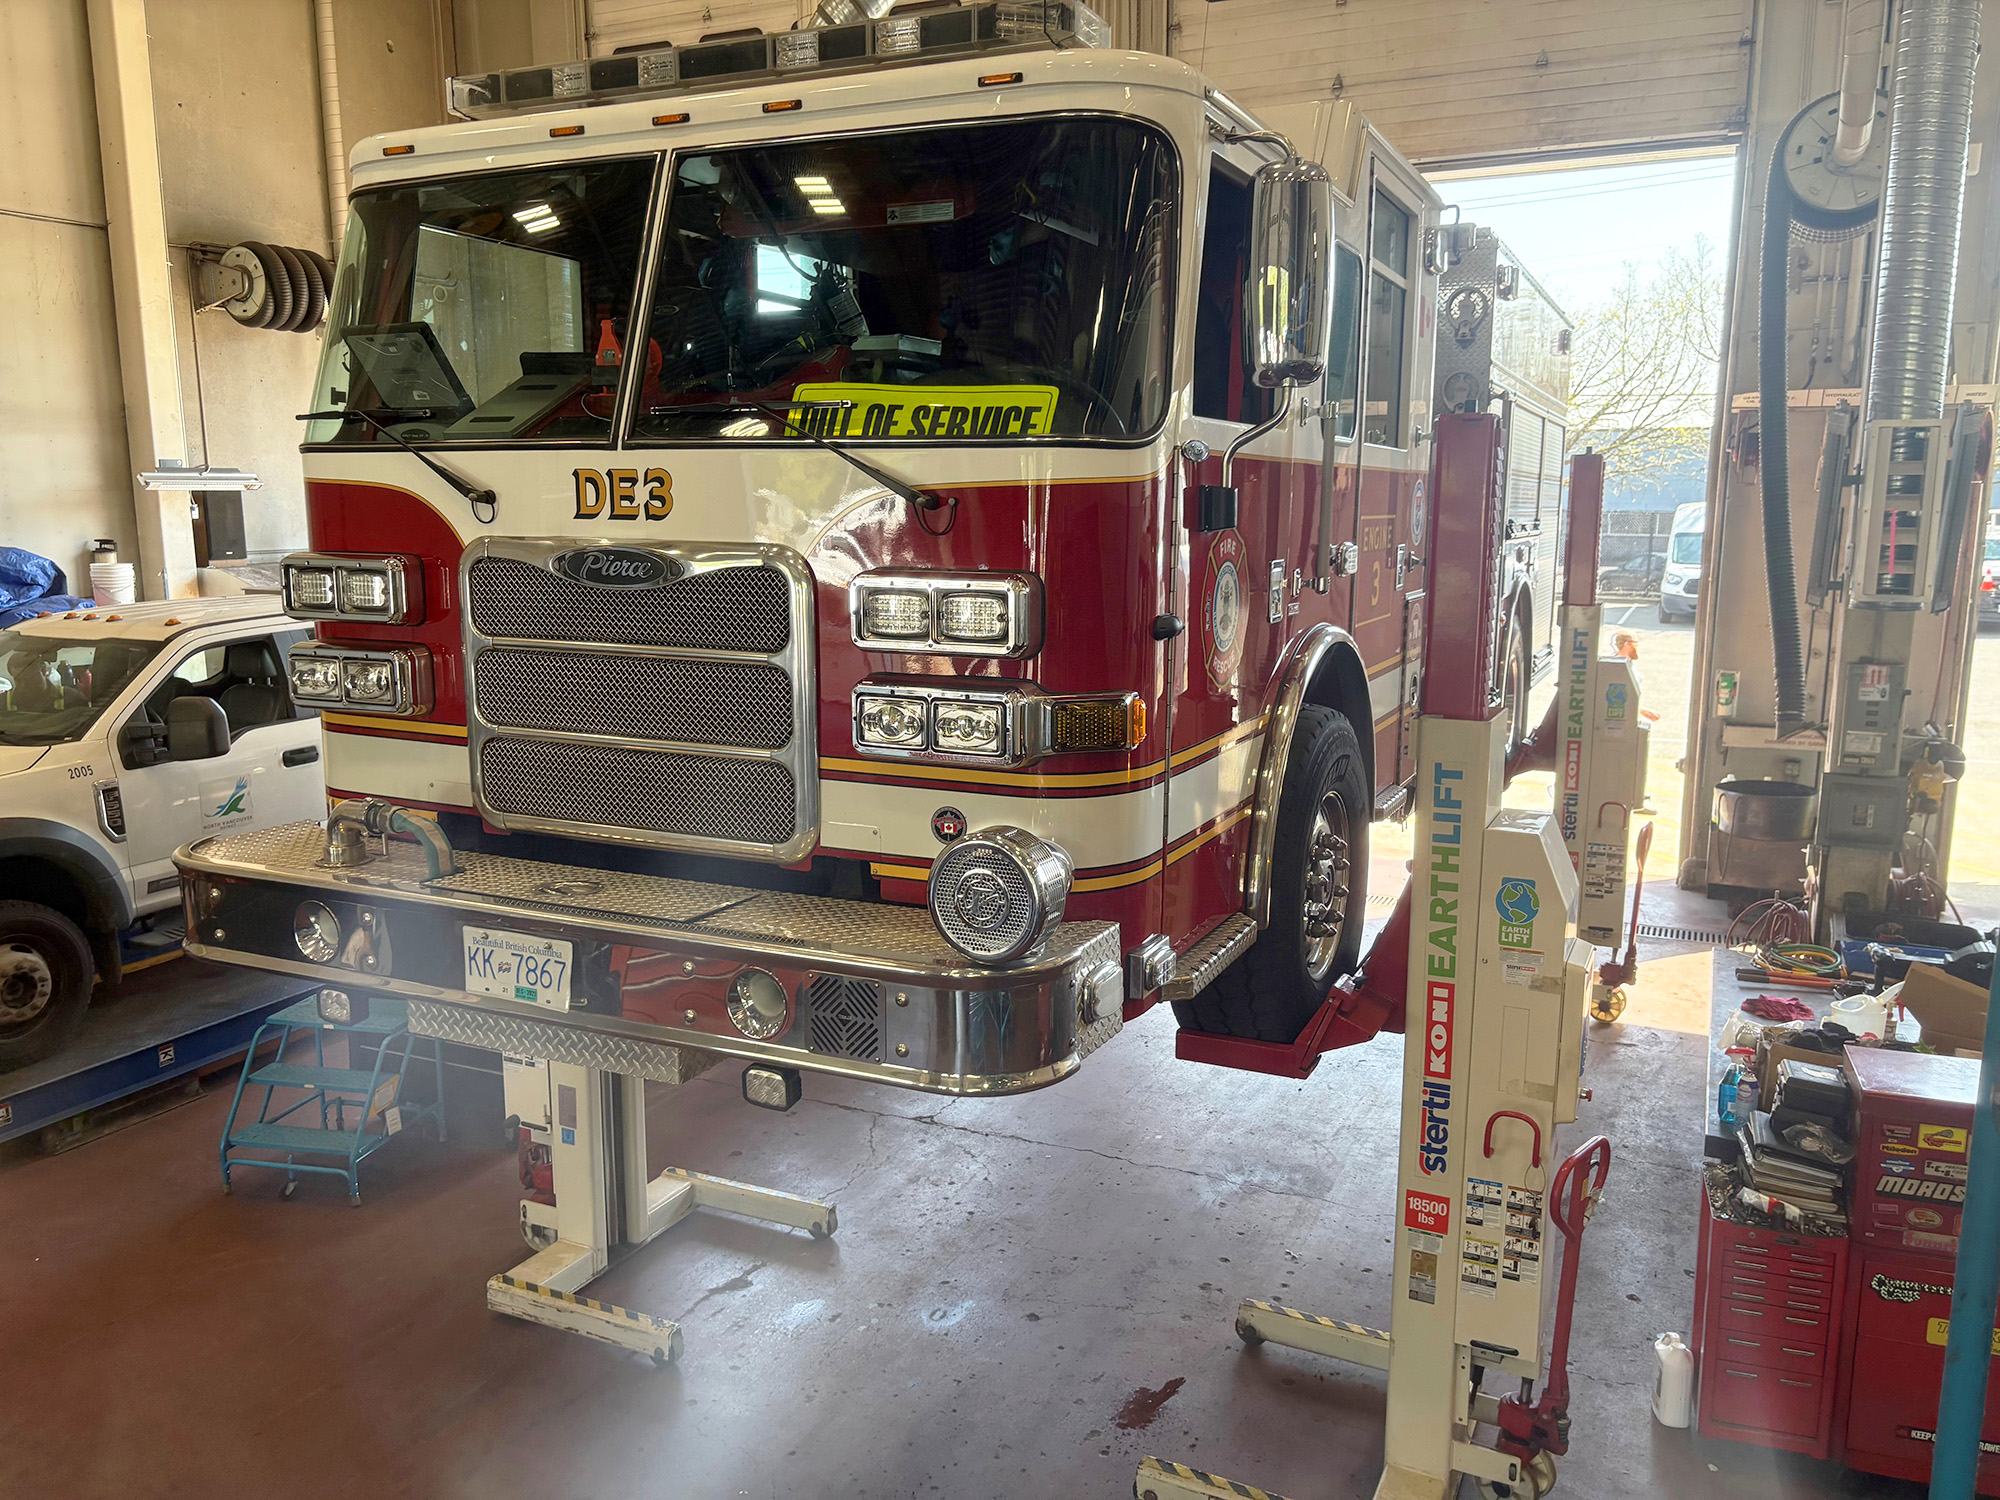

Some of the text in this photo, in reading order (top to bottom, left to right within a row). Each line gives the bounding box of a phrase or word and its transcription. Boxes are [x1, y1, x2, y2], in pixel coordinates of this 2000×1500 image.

[861, 403, 904, 436] OF
[907, 405, 1043, 436] SERVICE
[572, 467, 674, 521] DE3
[1220, 538, 1237, 558] FIRE
[1363, 525, 1392, 552] ENGINE
[579, 551, 653, 579] Pierce
[1371, 560, 1381, 607] 3
[1213, 649, 1236, 674] RESCUE
[1567, 628, 1590, 739] EARTHLIFT
[67, 764, 94, 780] 2005
[1567, 743, 1579, 789] KONI
[222, 815, 253, 825] VANCOUVER
[1562, 793, 1579, 842] stertil
[1501, 925, 1530, 935] EARTH
[1501, 932, 1530, 944] LIFT
[472, 936, 562, 958] Beautiful British Columbia
[467, 945, 567, 993] KK 7867
[1419, 762, 1464, 1176] stertil KONI EARTHLIFT
[1881, 1145, 1917, 1155] Milodon
[1875, 1175, 1967, 1203] MOROS
[1407, 1196, 1448, 1217] 18500
[1418, 1212, 1435, 1226] lbs
[1910, 1429, 1931, 1441] KEEP
[1979, 1441, 2000, 1453] RAWE
